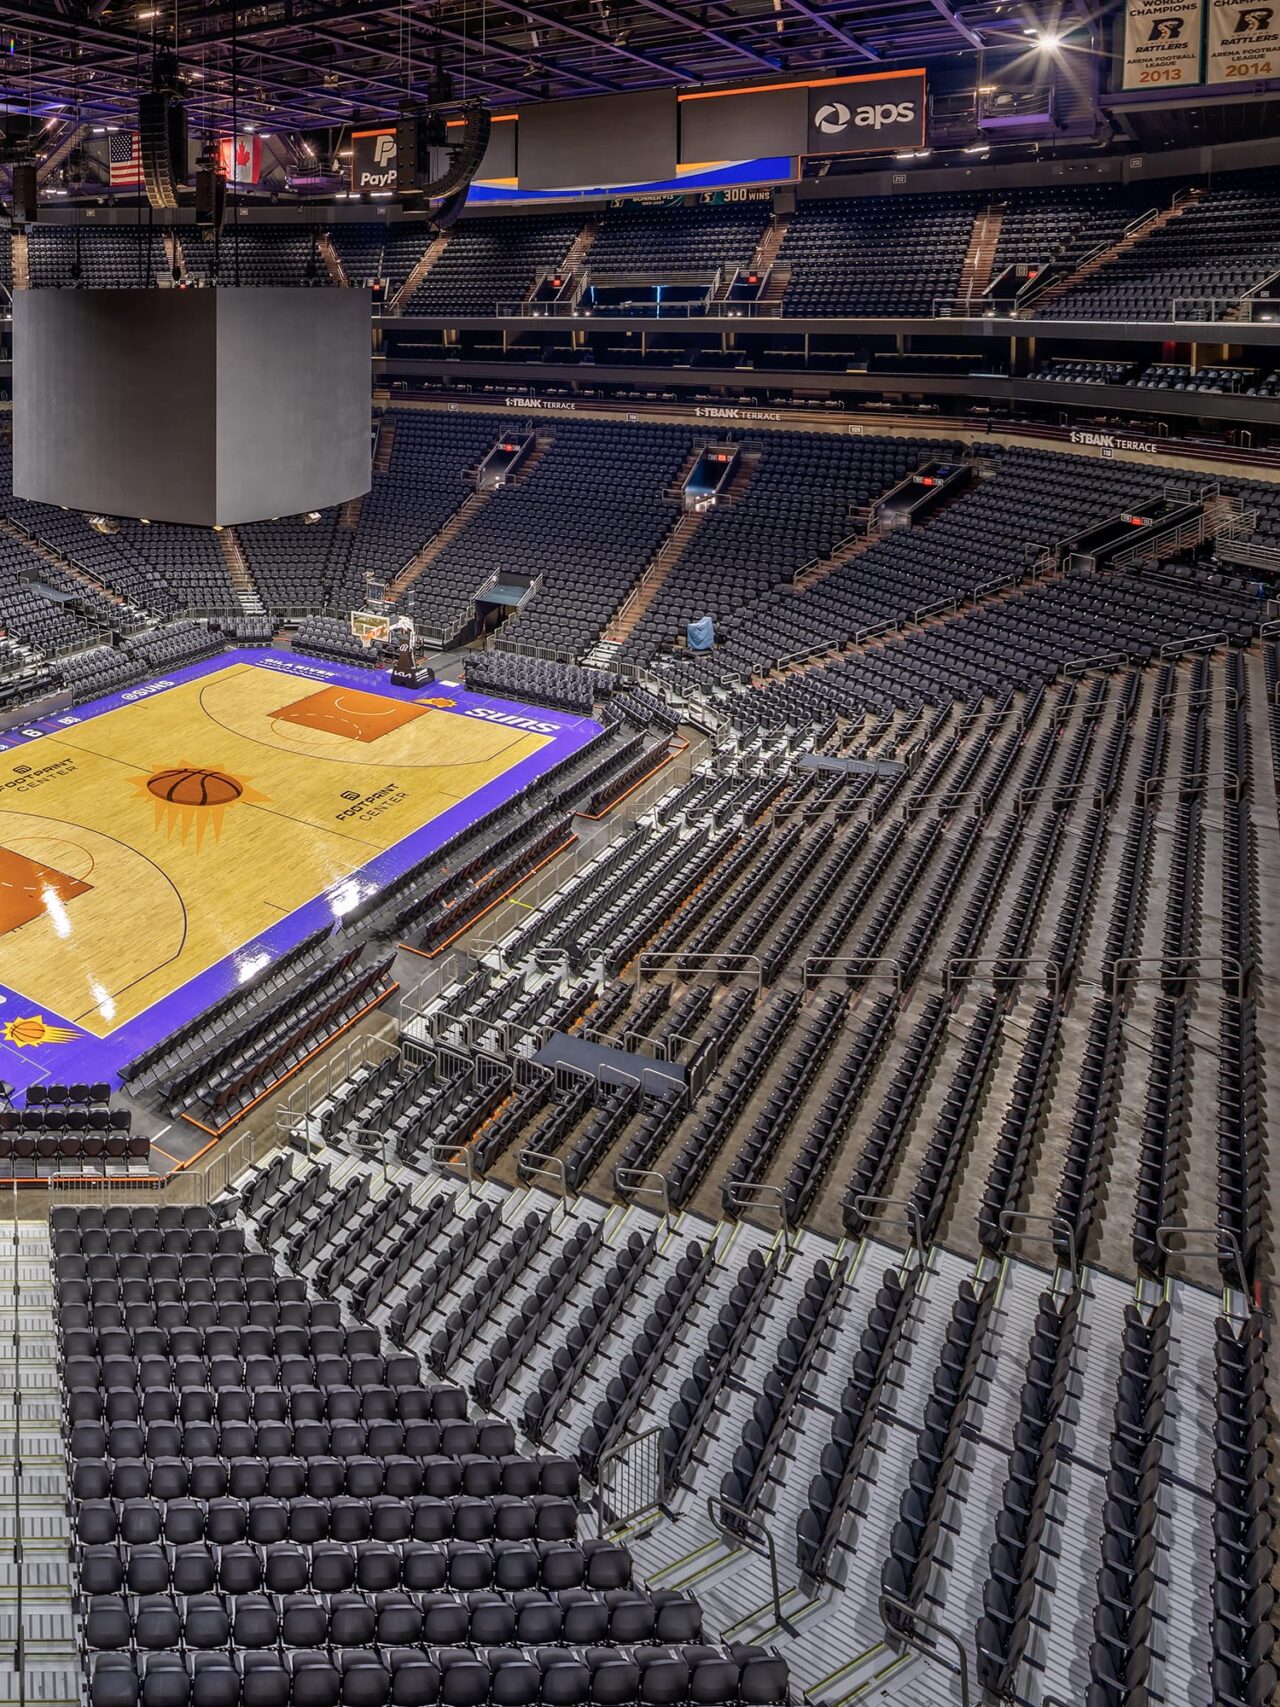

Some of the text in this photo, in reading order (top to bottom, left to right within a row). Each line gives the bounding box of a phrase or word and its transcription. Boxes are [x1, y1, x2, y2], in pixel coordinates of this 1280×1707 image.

[1129, 3, 1198, 17] CHAMPIONS
[1220, 34, 1279, 46] RATTLERS
[1135, 42, 1189, 54] RATTLERS
[1211, 50, 1240, 58] ARENA
[1155, 53, 1197, 62] FOOTBALL
[1231, 53, 1266, 62] LEAGUE
[1146, 61, 1177, 69] LEAGUE
[1225, 62, 1272, 78] 2014
[1139, 69, 1182, 83] 2013
[854, 102, 915, 130] aps
[723, 188, 770, 202] 300 WINS
[542, 401, 575, 410] TERRACE
[741, 411, 781, 421] TERRACE
[1115, 439, 1158, 453] TERRACE
[122, 680, 175, 701] @SUNS
[465, 707, 561, 733] SUNS
[22, 728, 44, 738] 6
[17, 765, 79, 792] CENTER
[335, 783, 399, 821] FOOTPRINT
[359, 792, 409, 821] CENTER
